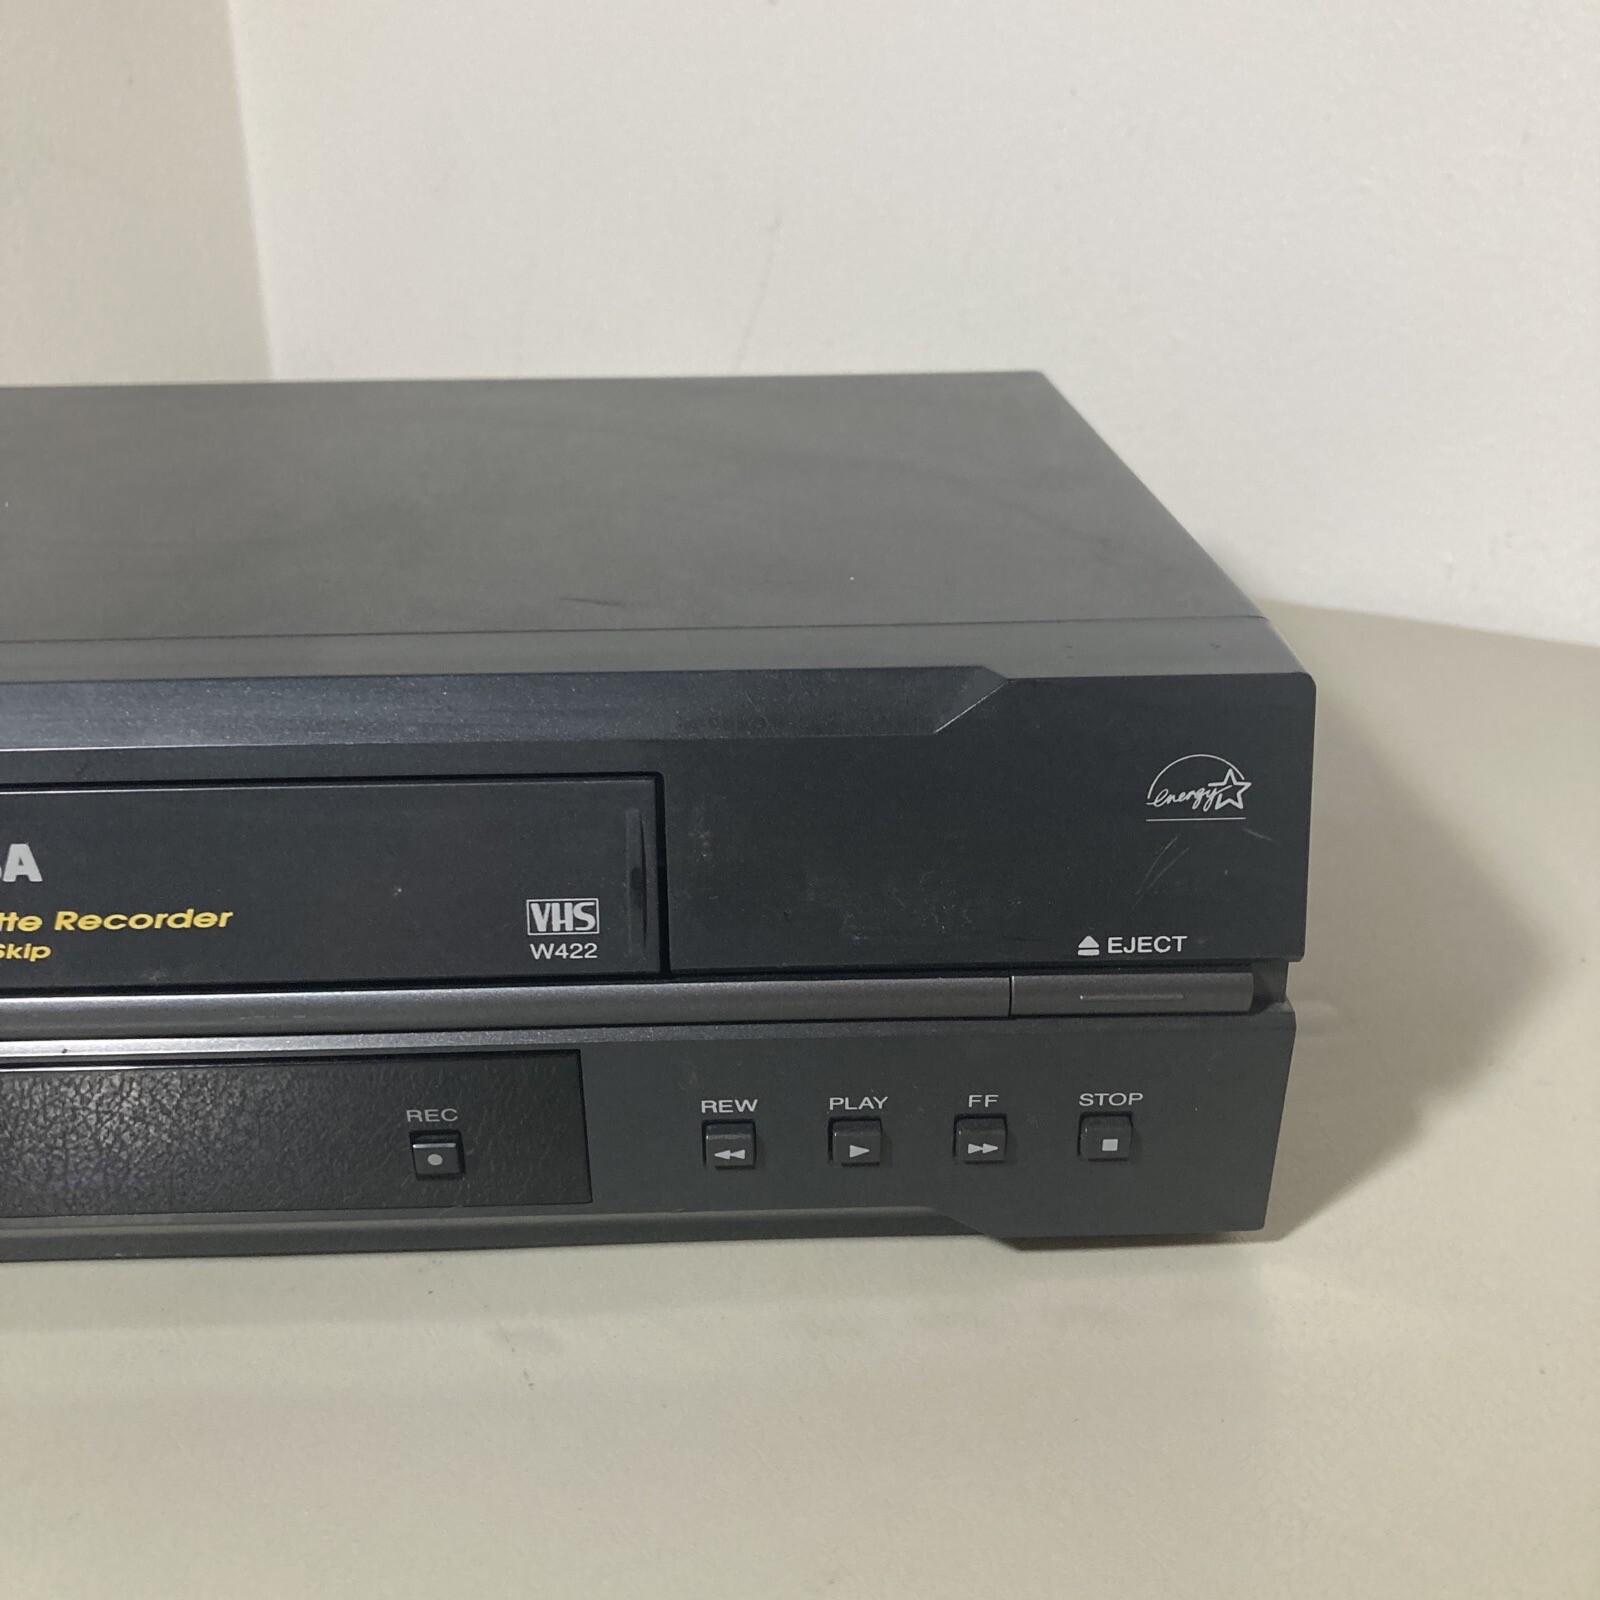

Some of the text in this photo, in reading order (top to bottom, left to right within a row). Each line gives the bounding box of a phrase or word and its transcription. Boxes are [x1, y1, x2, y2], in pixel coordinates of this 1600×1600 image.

[1149, 784, 1230, 812] energy
[0, 843, 43, 882] A
[54, 908, 234, 931] Recorder
[530, 901, 596, 932] VHS
[529, 942, 598, 960] W422
[1107, 935, 1188, 954] EJECT
[700, 1098, 759, 1113] REW
[828, 1096, 889, 1111] PLAY
[967, 1094, 999, 1108] FF
[1078, 1092, 1144, 1107] STOP
[405, 1108, 458, 1122] REC
